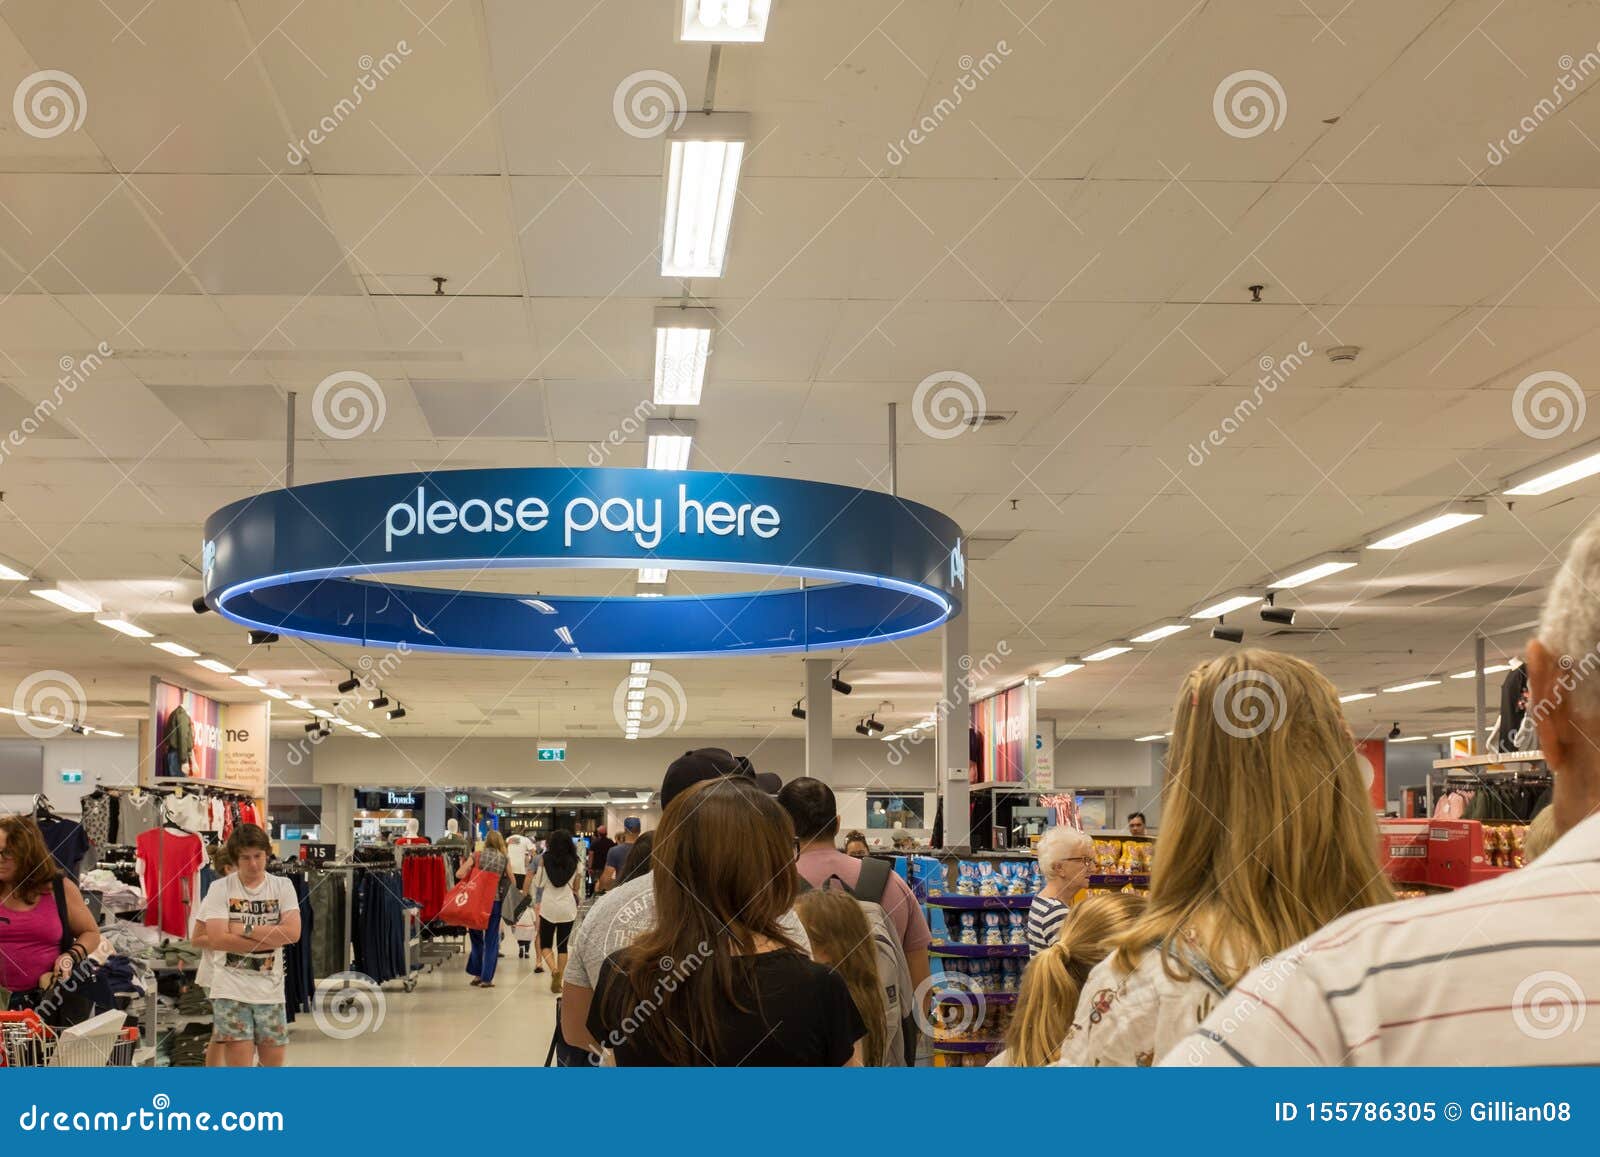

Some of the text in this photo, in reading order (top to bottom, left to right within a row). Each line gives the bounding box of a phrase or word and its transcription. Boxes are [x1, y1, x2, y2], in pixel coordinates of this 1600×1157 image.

[385, 483, 781, 552] please pay here
[387, 791, 416, 805] Prouds
